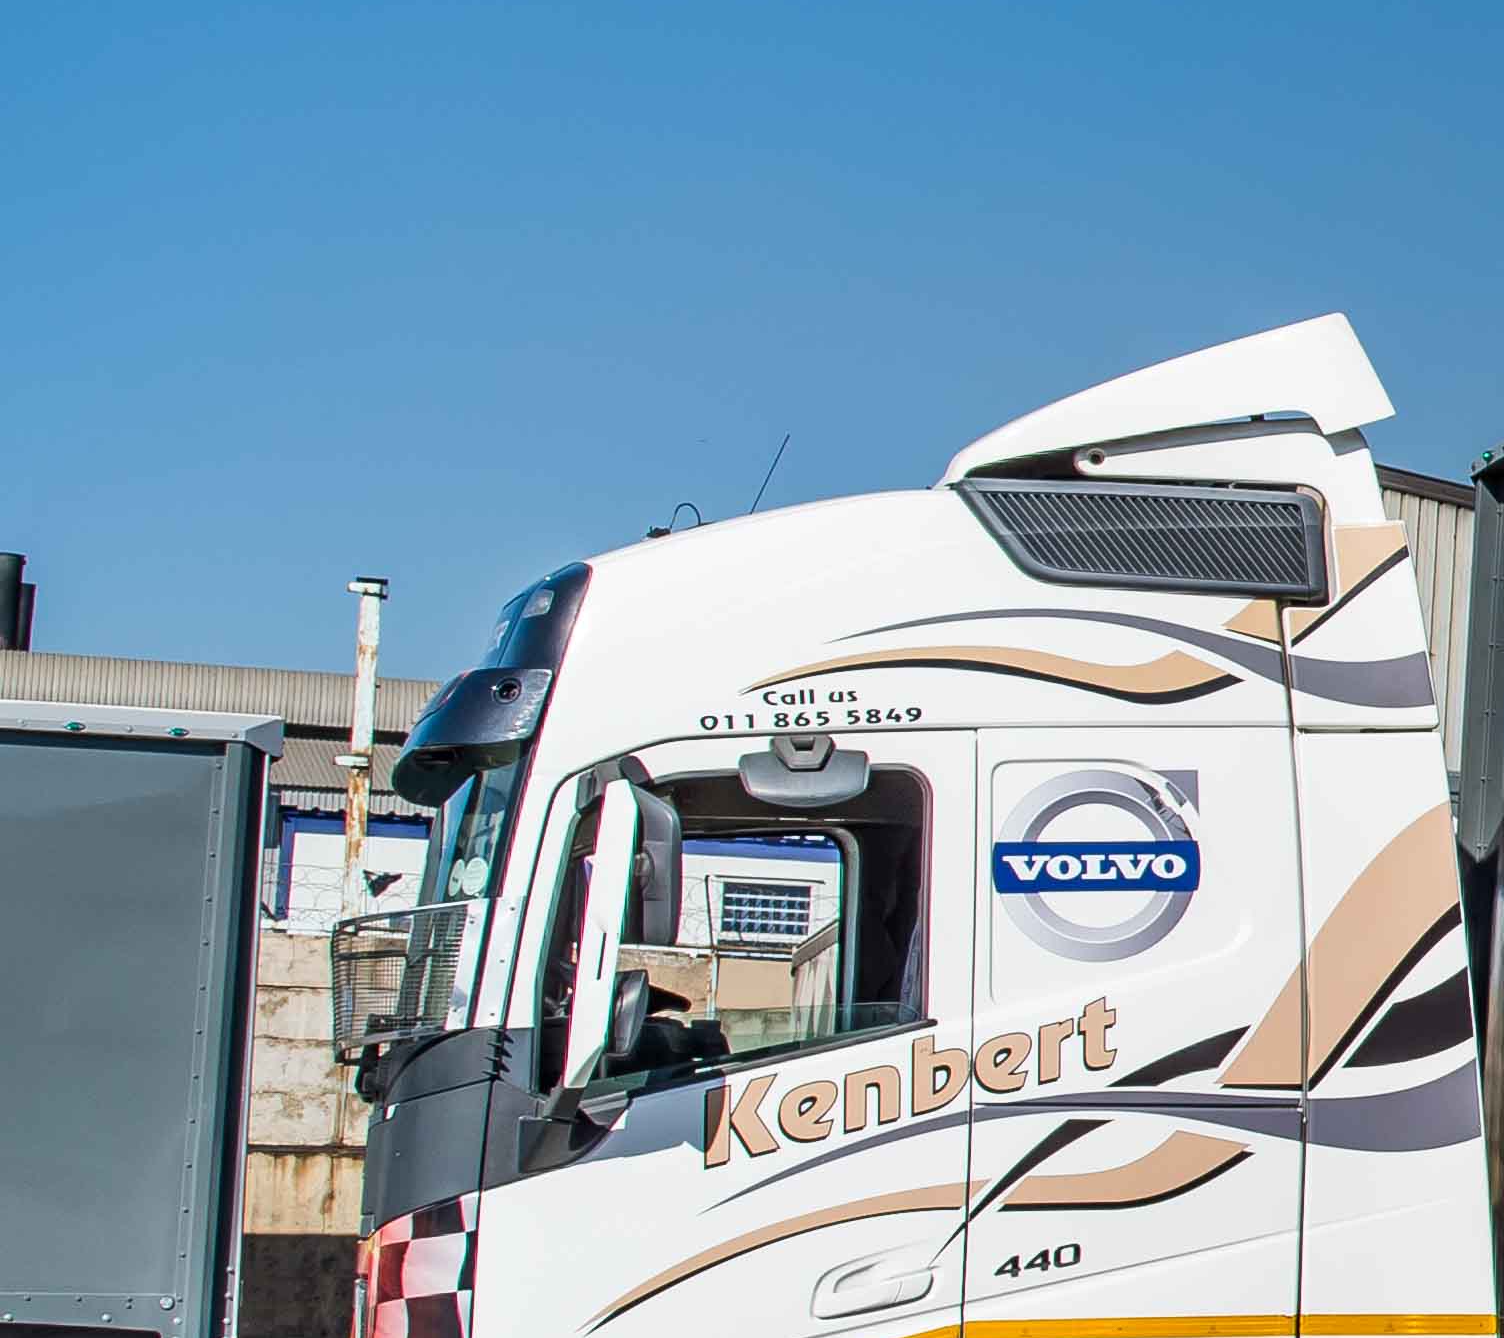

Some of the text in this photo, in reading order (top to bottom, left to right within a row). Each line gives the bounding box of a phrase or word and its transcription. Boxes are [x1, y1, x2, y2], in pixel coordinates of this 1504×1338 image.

[763, 689, 858, 706] Call us
[700, 707, 922, 731] 011 865 5849
[1002, 853, 1187, 881] VOLVO
[703, 996, 1117, 1169] Kenbert
[994, 1243, 1081, 1277] 440
